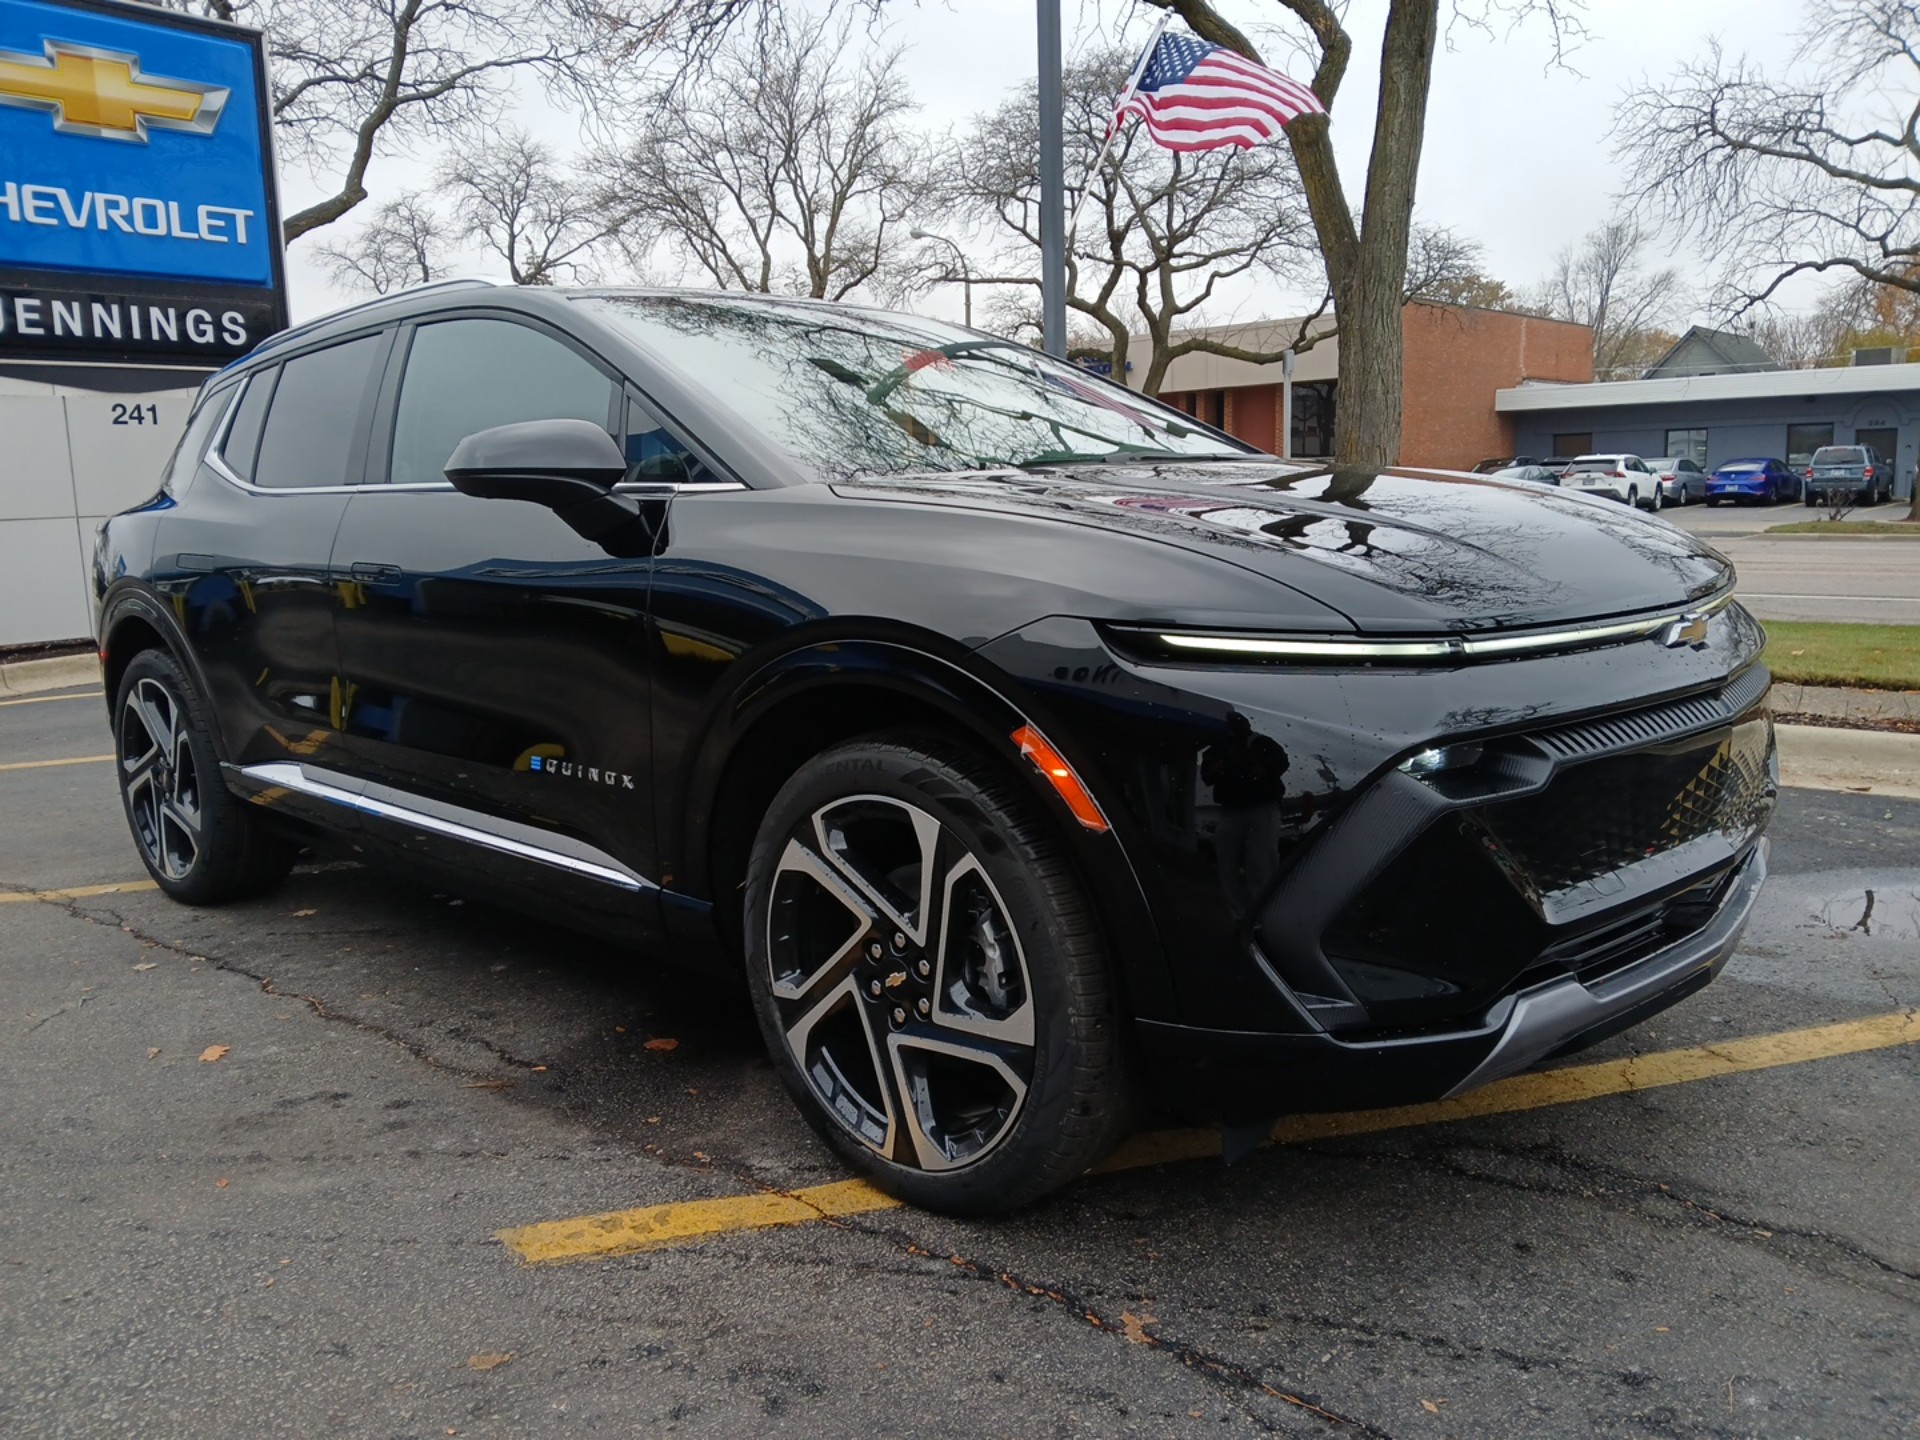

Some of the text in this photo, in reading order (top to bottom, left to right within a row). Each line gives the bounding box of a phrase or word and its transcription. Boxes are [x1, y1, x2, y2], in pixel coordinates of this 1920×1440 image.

[0, 297, 247, 346] ENNINGS
[111, 403, 158, 425] 241
[530, 756, 635, 789] EQUINOX
